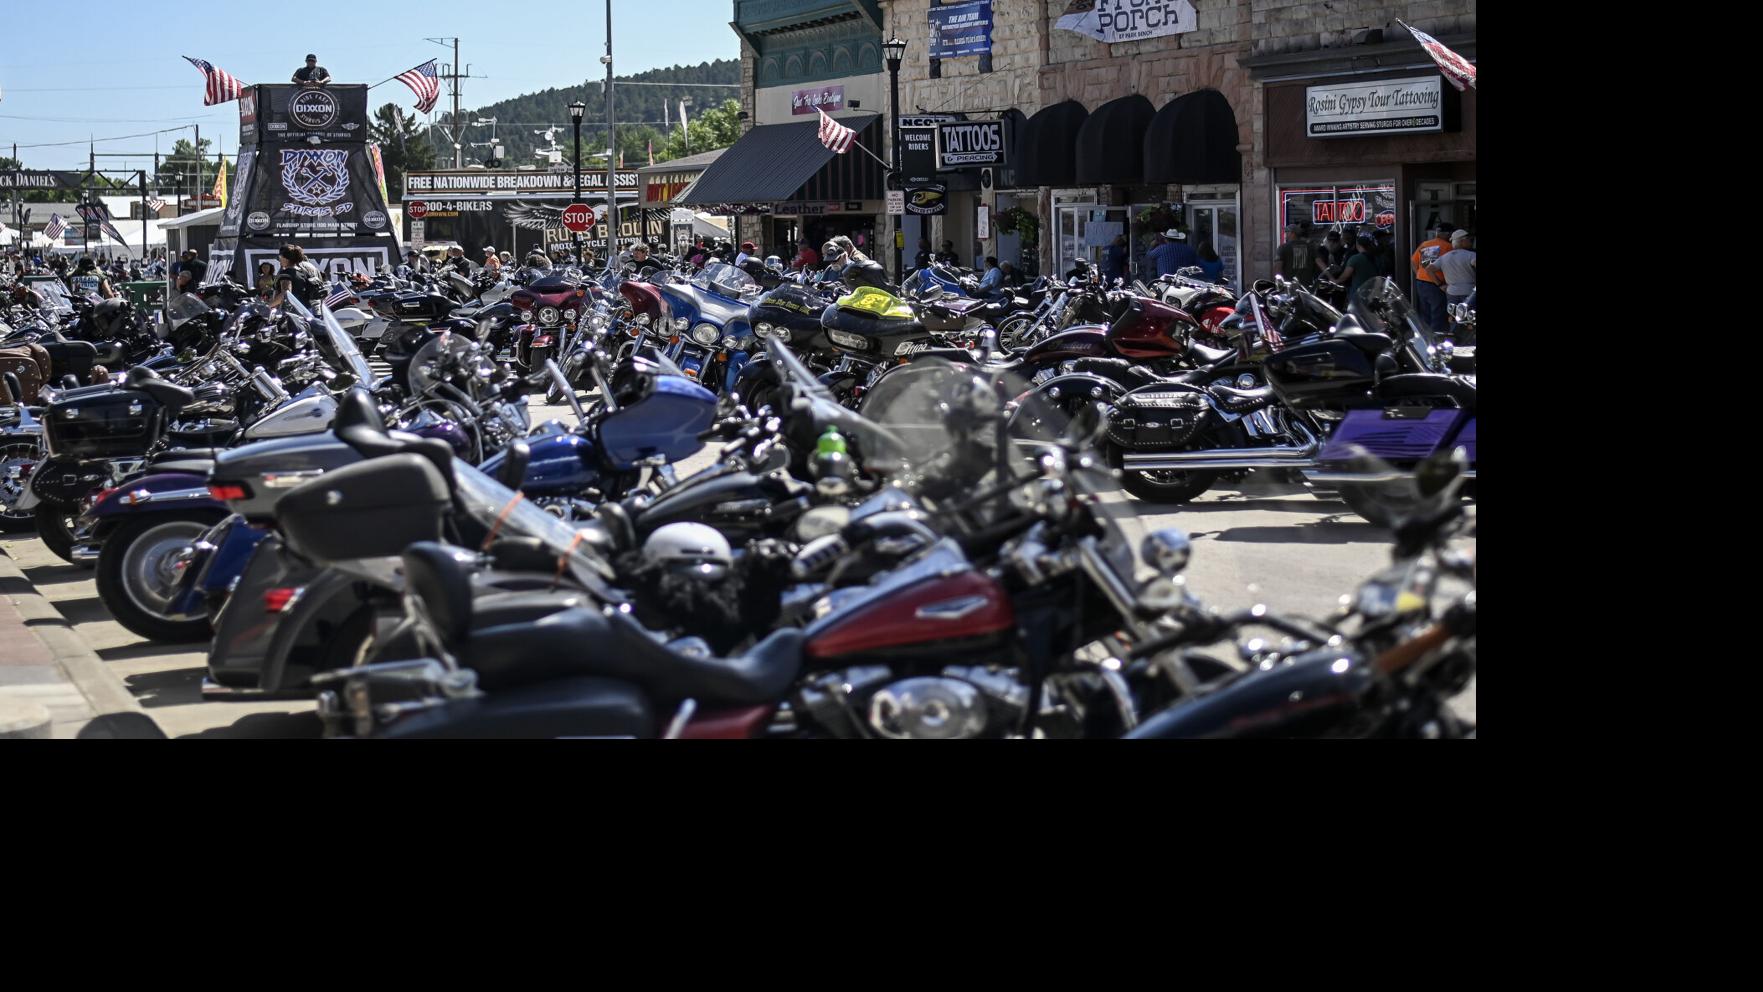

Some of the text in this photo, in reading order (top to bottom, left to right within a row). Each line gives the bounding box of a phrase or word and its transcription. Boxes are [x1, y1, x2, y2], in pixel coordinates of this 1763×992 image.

[1309, 87, 1439, 115] Rosini Gypsy Tour Tattooing
[295, 104, 332, 113] DIXXON
[1360, 121, 1376, 129] SERVING
[1377, 120, 1392, 128] STURGIS
[1416, 117, 1434, 126] DECADES
[904, 133, 931, 142] WELCOME
[942, 124, 1000, 152] TATTOOS
[908, 142, 929, 151] RIDERS
[279, 149, 349, 167] DIXXON
[956, 154, 994, 162] PIERCING
[16, 172, 57, 188] DANIEL'S
[409, 176, 432, 189] FREE
[434, 175, 495, 189] NATIONWIDE
[497, 174, 560, 188] BREAKDOWN
[576, 174, 604, 187] EGAL
[335, 203, 353, 214] SD
[409, 205, 427, 213] STOP
[774, 203, 825, 214] Leather
[1315, 202, 1363, 222] TATTOO
[564, 212, 593, 223] STOP
[597, 220, 663, 239] BOWN
